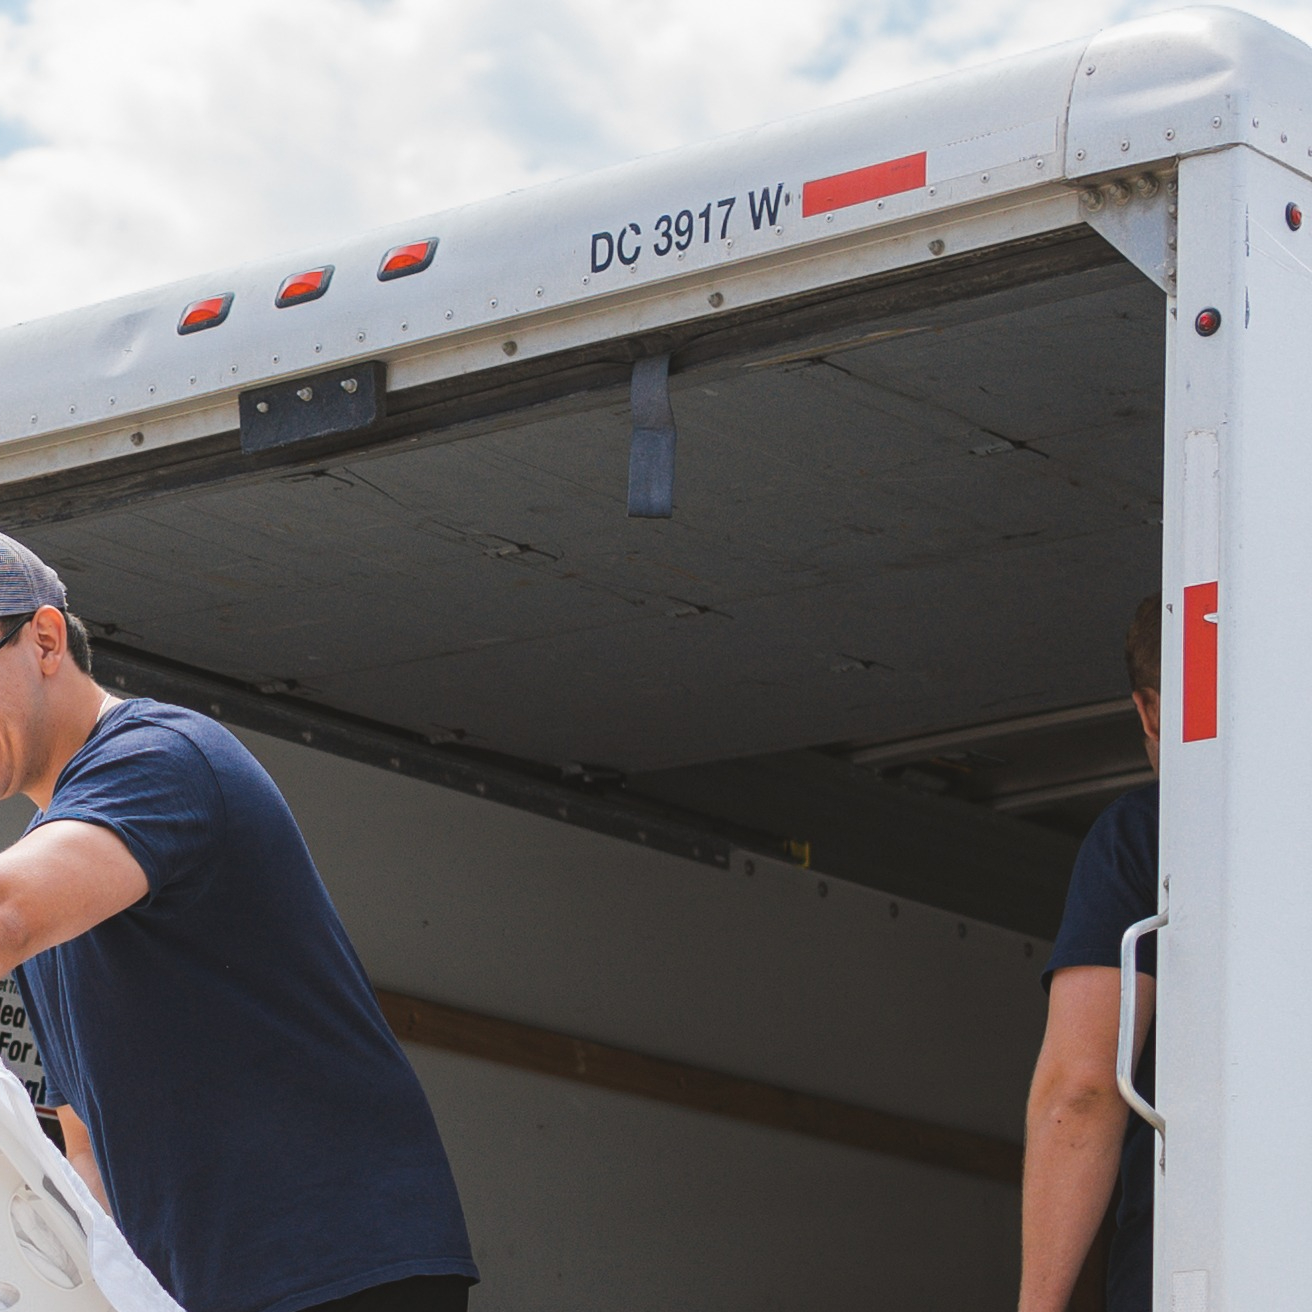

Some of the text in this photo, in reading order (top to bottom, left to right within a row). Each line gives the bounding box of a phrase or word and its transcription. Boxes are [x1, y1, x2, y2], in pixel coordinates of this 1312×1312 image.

[591, 182, 785, 273] DC 3917 W
